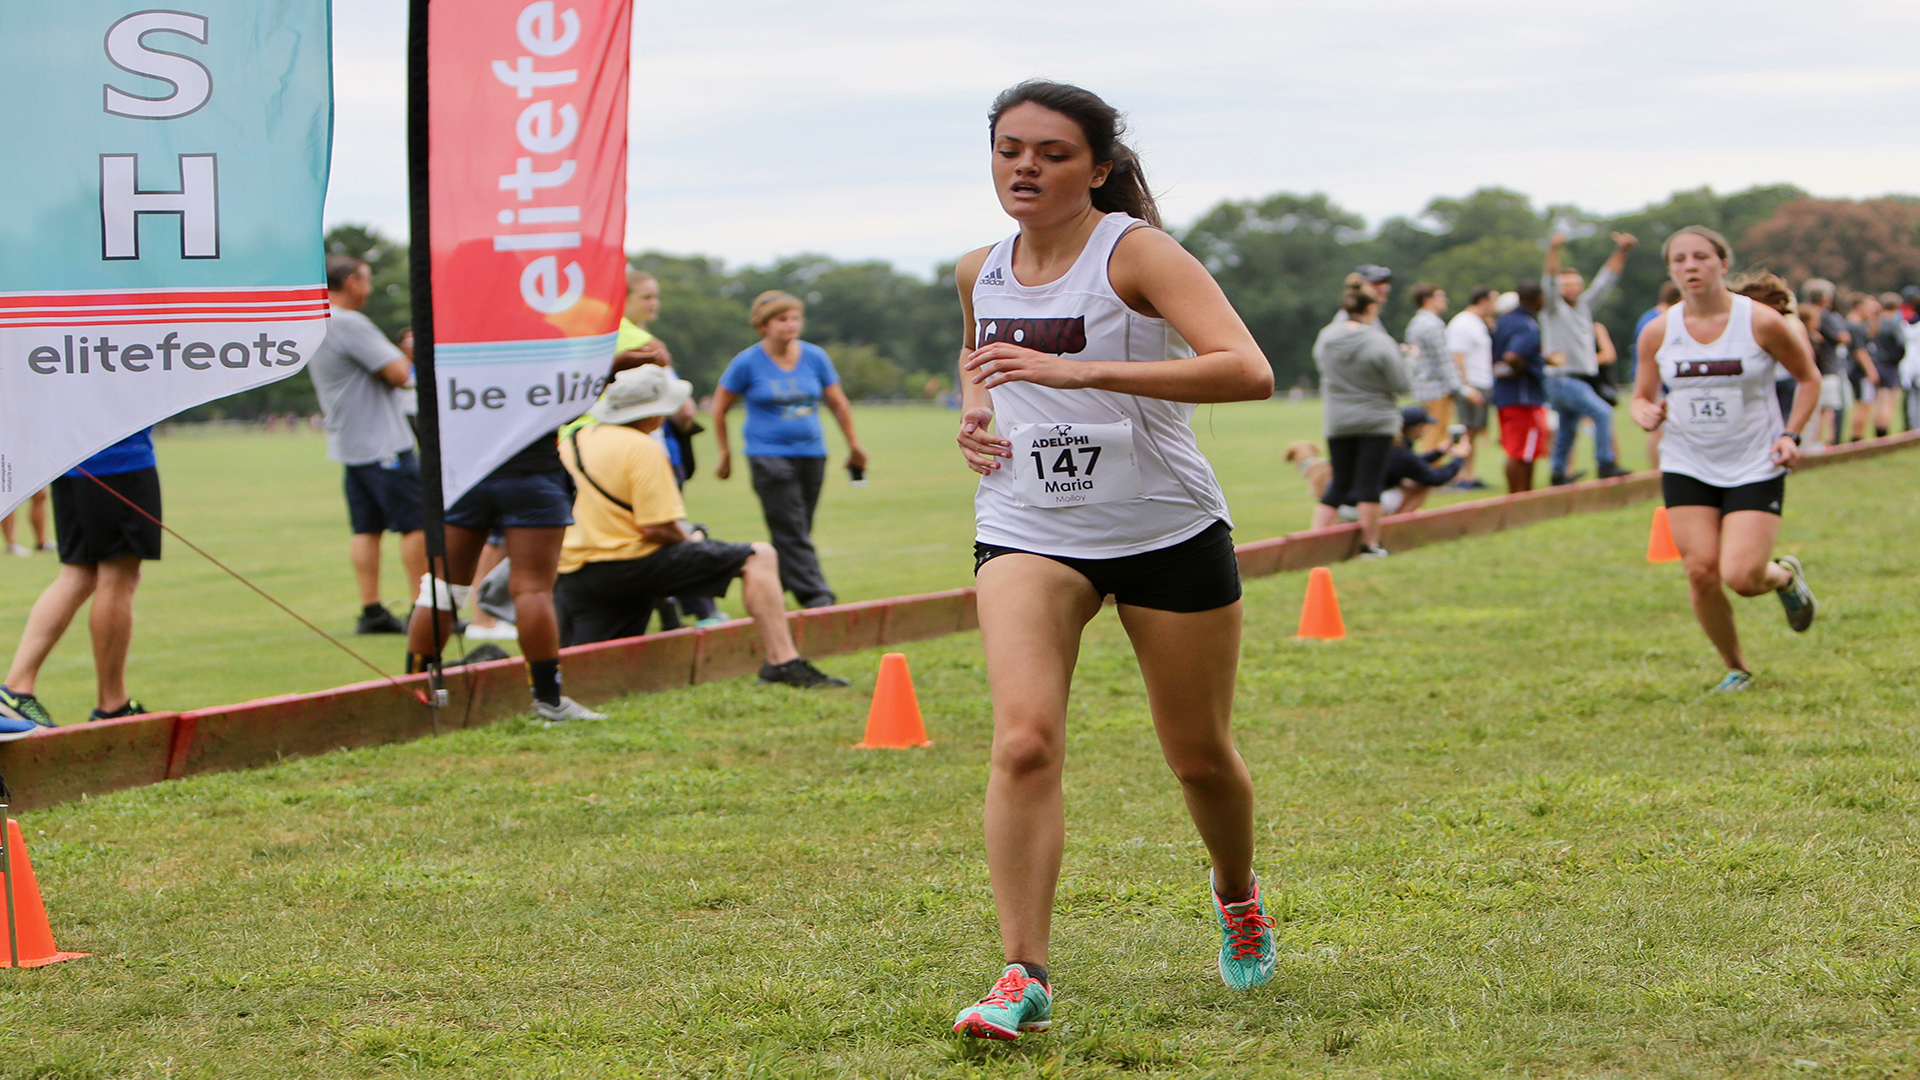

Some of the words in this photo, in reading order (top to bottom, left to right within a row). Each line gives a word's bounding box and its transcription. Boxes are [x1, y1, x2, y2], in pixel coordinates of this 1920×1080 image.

[979, 277, 1005, 286] adidas
[28, 331, 301, 375] elitefeats
[449, 377, 507, 411] be
[526, 371, 608, 407] elite
[1689, 401, 1726, 417] 145
[1032, 435, 1090, 449] ADELPHI
[1030, 446, 1102, 480] 147
[1045, 478, 1094, 494] Maria
[1056, 494, 1087, 503] Molloy
